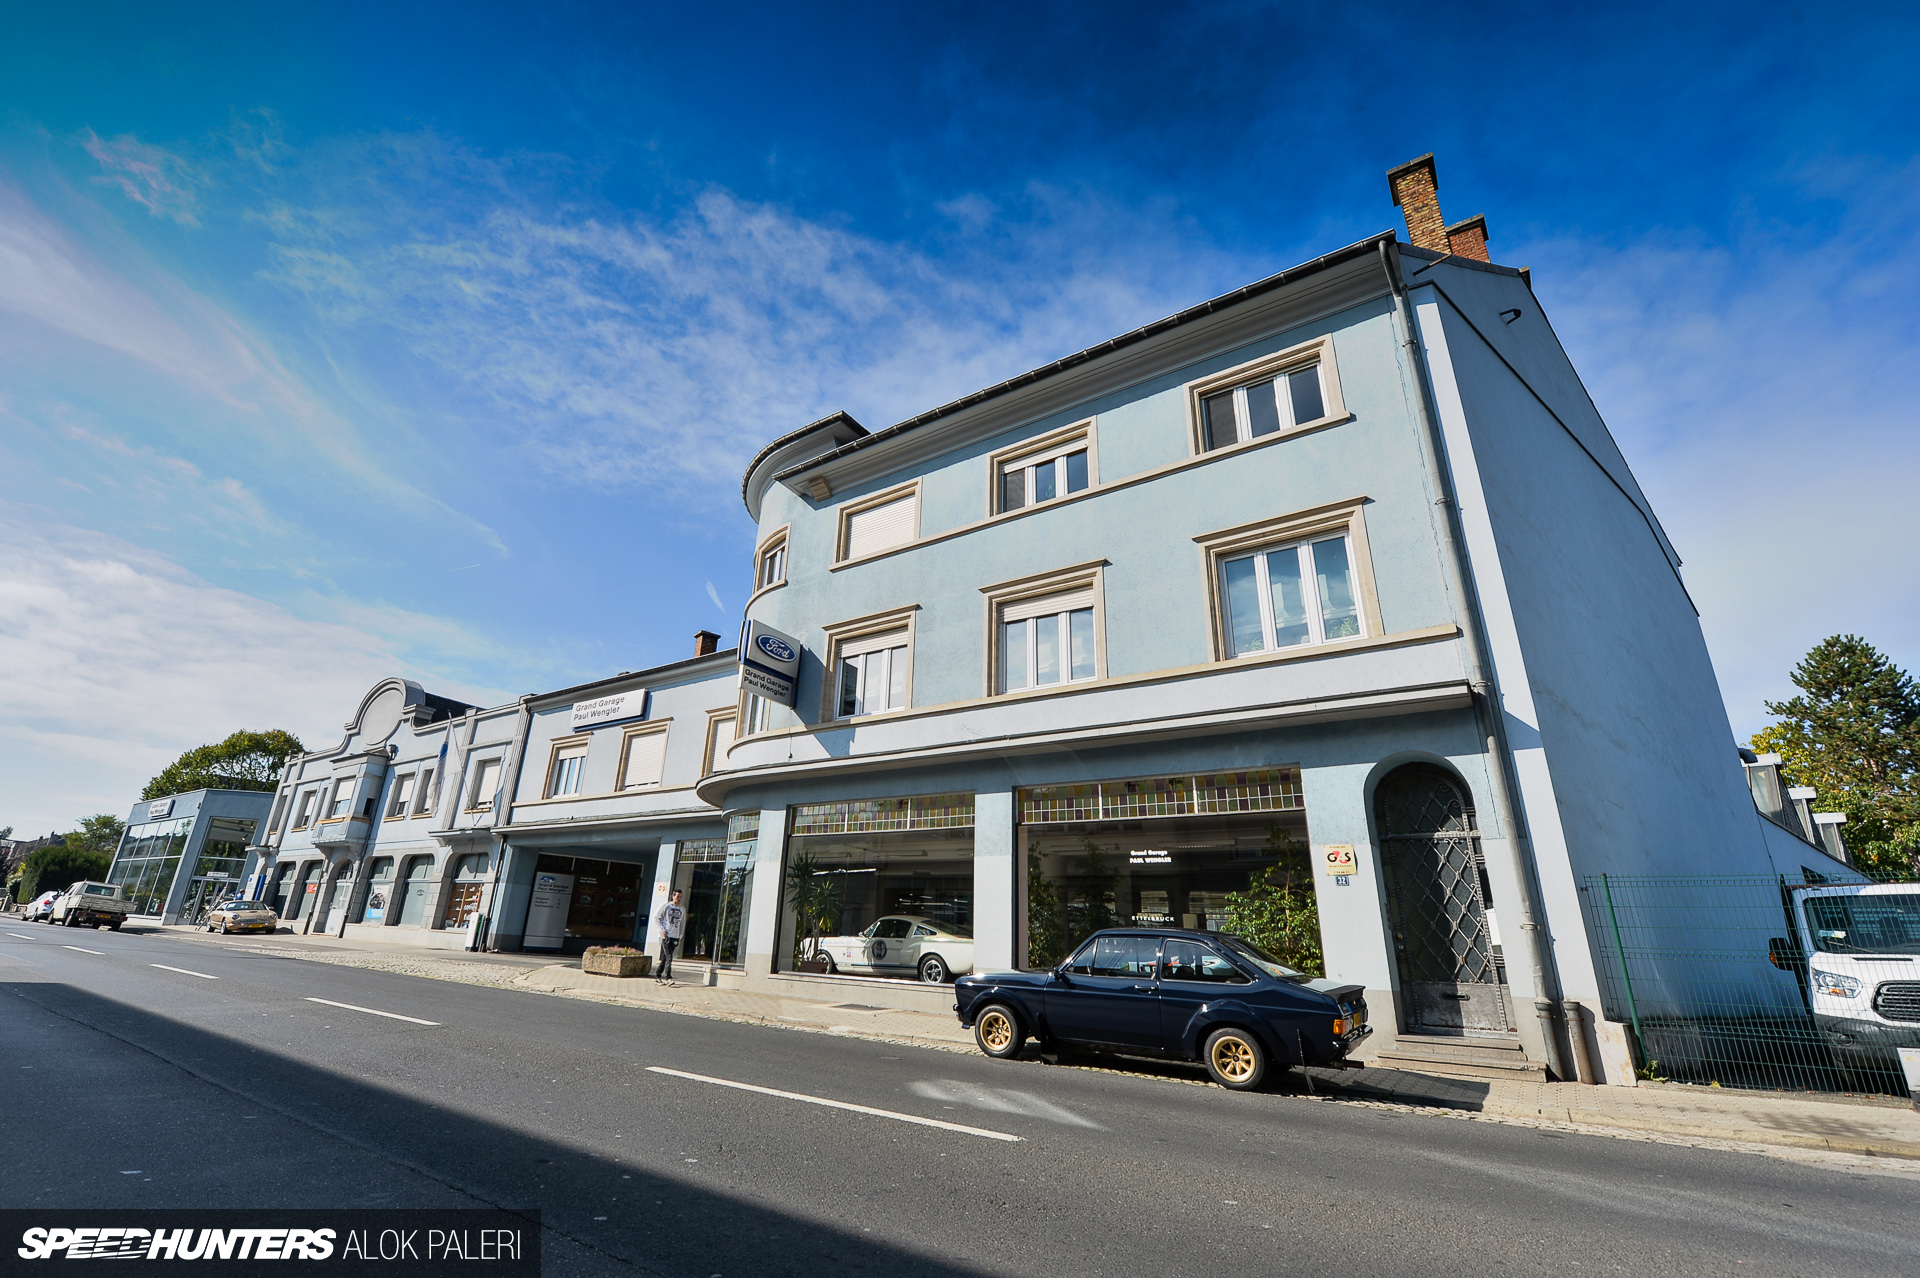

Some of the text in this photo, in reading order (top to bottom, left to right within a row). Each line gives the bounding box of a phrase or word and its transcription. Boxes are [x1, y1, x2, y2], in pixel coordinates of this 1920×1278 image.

[766, 638, 790, 658] Ford
[744, 676, 787, 698] Paul Wengler
[745, 668, 790, 692] Grand Garage
[575, 696, 625, 712] Grand Garage
[573, 706, 621, 721] Paul Wengler
[1327, 850, 1351, 864] G4S
